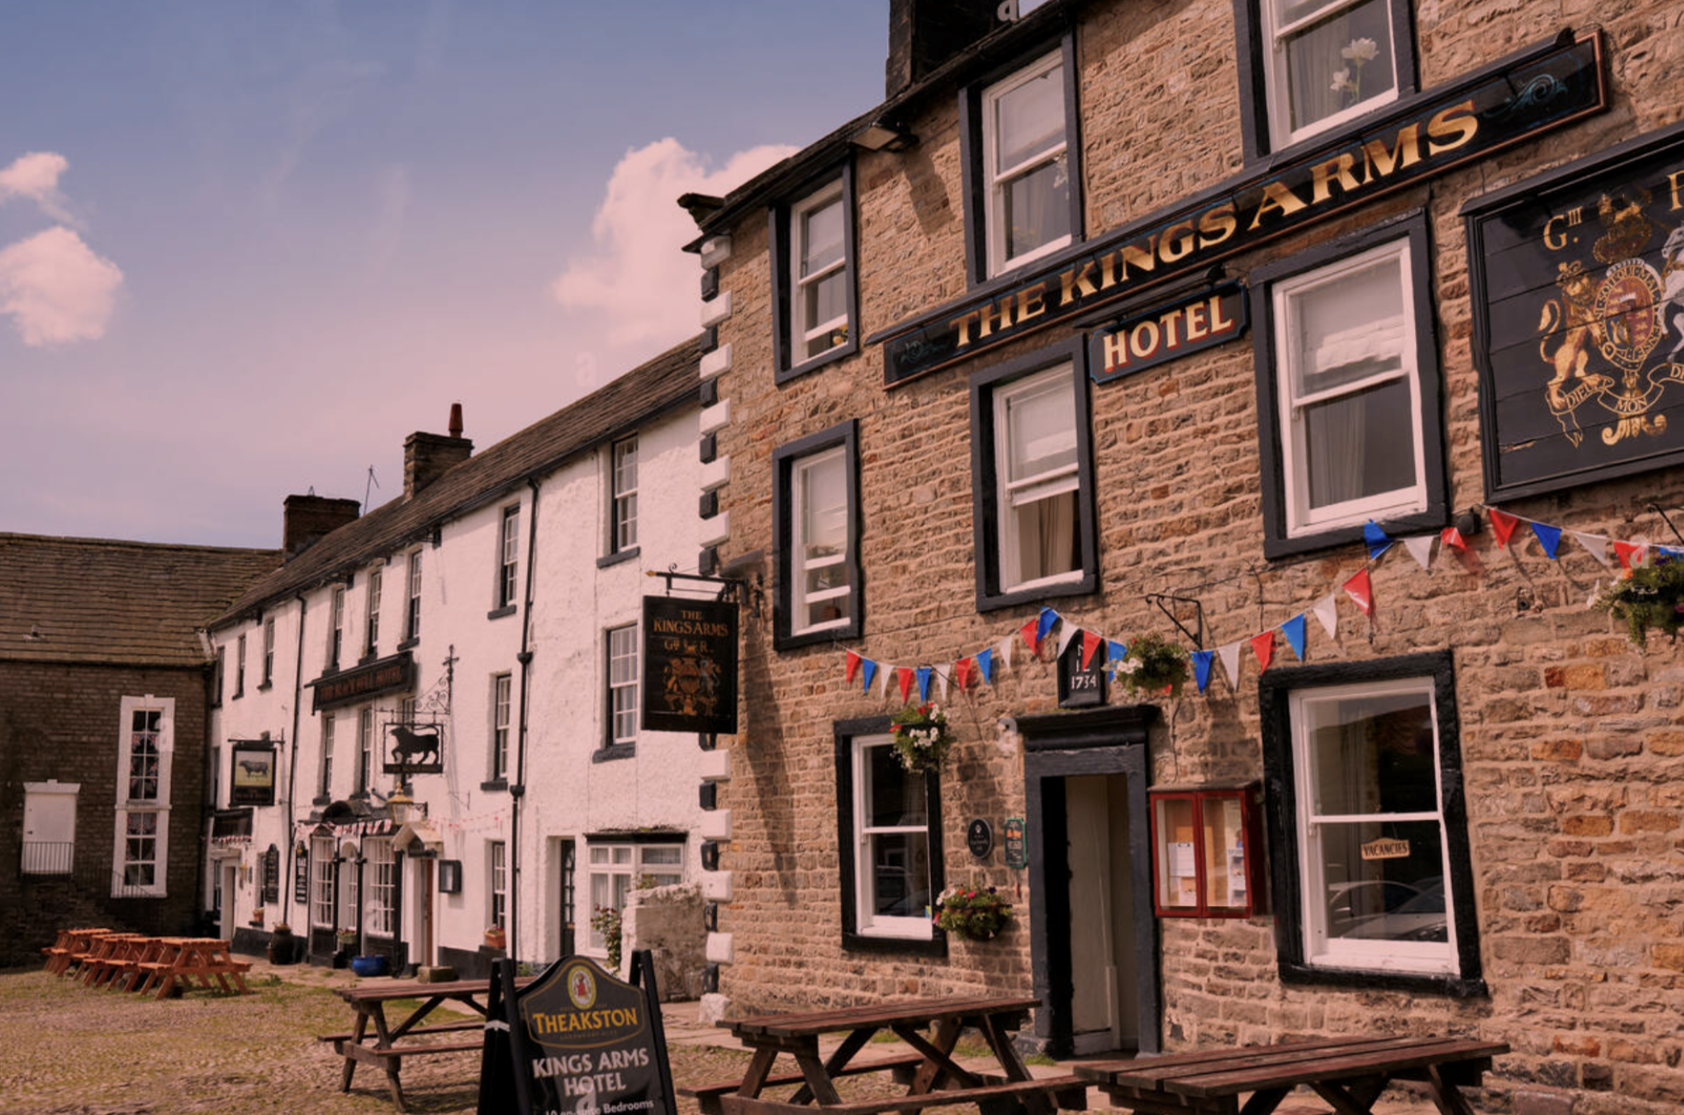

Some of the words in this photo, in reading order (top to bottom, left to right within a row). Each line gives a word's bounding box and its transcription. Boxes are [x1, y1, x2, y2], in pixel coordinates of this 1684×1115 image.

[950, 282, 1047, 348] THE
[1059, 202, 1238, 306] KINGS
[1247, 100, 1479, 231] ARMS
[1103, 296, 1234, 373] HOTEL
[1615, 395, 1647, 413] MON
[681, 610, 702, 620] THE
[653, 619, 692, 635] KINGS
[693, 621, 728, 637] ARMS
[1071, 675, 1097, 690] 1734
[1363, 842, 1408, 857] VACANCIES
[532, 1007, 638, 1035] THEAKSTON
[532, 1053, 593, 1078] KINGS
[598, 1047, 649, 1070] ARMS
[564, 1072, 627, 1097] HOTEL
[603, 1099, 654, 1114] Bedrooms
